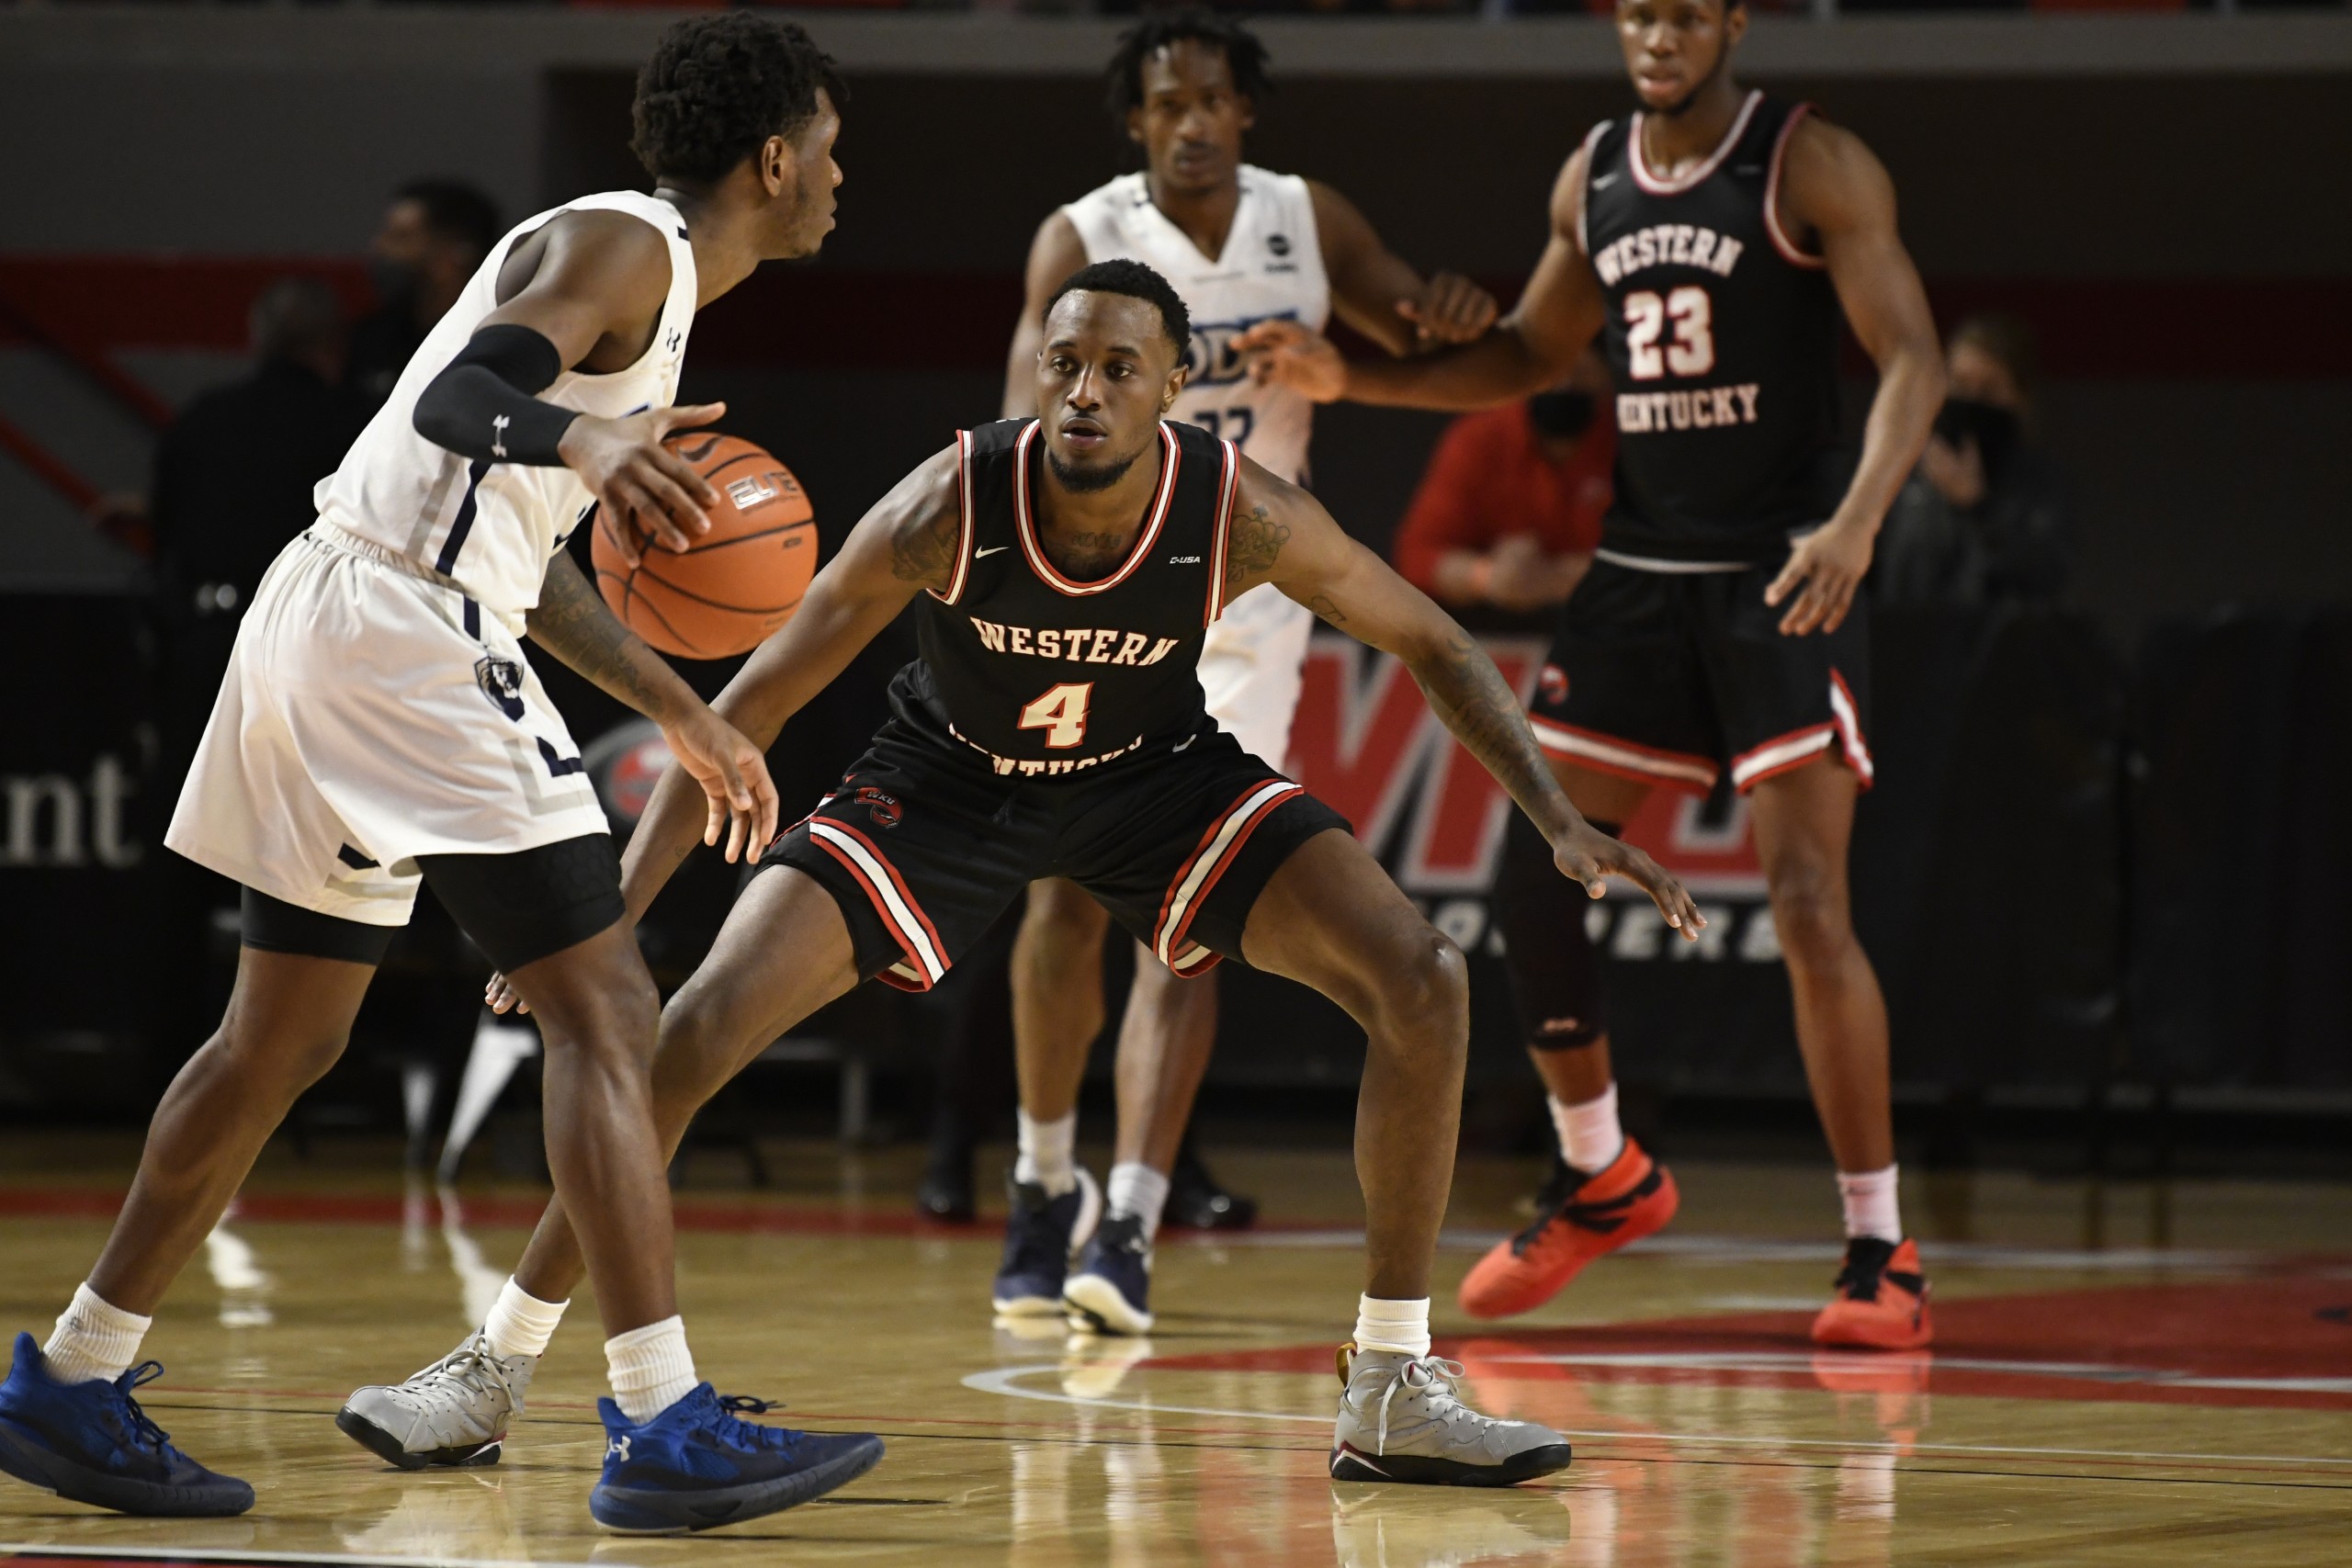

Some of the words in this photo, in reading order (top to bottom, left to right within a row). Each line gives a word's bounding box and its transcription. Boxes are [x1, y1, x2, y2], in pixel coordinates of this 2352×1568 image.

[1595, 225, 1744, 287] WESTERN
[1623, 286, 1715, 380] 23
[969, 615, 1179, 666] WESTERN
[1017, 681, 1095, 749] 4
[867, 791, 896, 806] WKU
